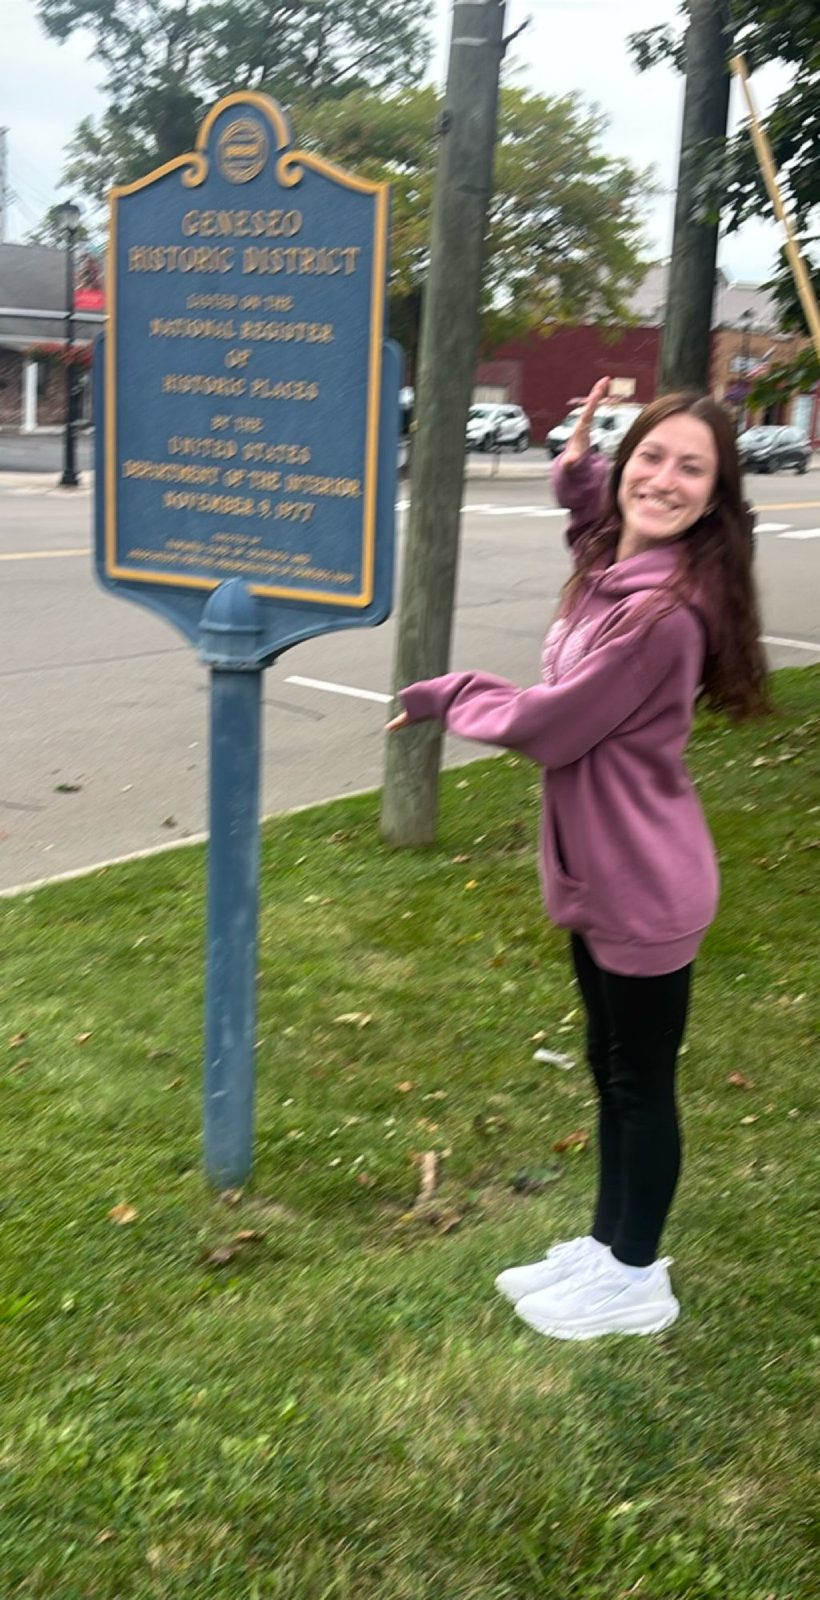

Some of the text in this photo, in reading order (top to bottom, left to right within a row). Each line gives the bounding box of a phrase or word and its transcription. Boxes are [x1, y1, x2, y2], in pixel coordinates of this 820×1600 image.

[183, 210, 302, 237] GENESEO
[129, 246, 361, 275] HISTORIC DISTRICT
[264, 295, 295, 312] THE
[149, 318, 335, 344] NATIONAL REGISTER
[225, 348, 252, 368] OF
[162, 374, 319, 401] HISTORIC PLACES
[233, 416, 264, 433] THE
[168, 435, 311, 465] UNITED STATES
[122, 460, 221, 485] DEPARTMENT
[223, 468, 247, 488] OF
[247, 470, 282, 491] THE
[164, 492, 255, 516] NOVEMBER
[273, 501, 315, 522] 1977
